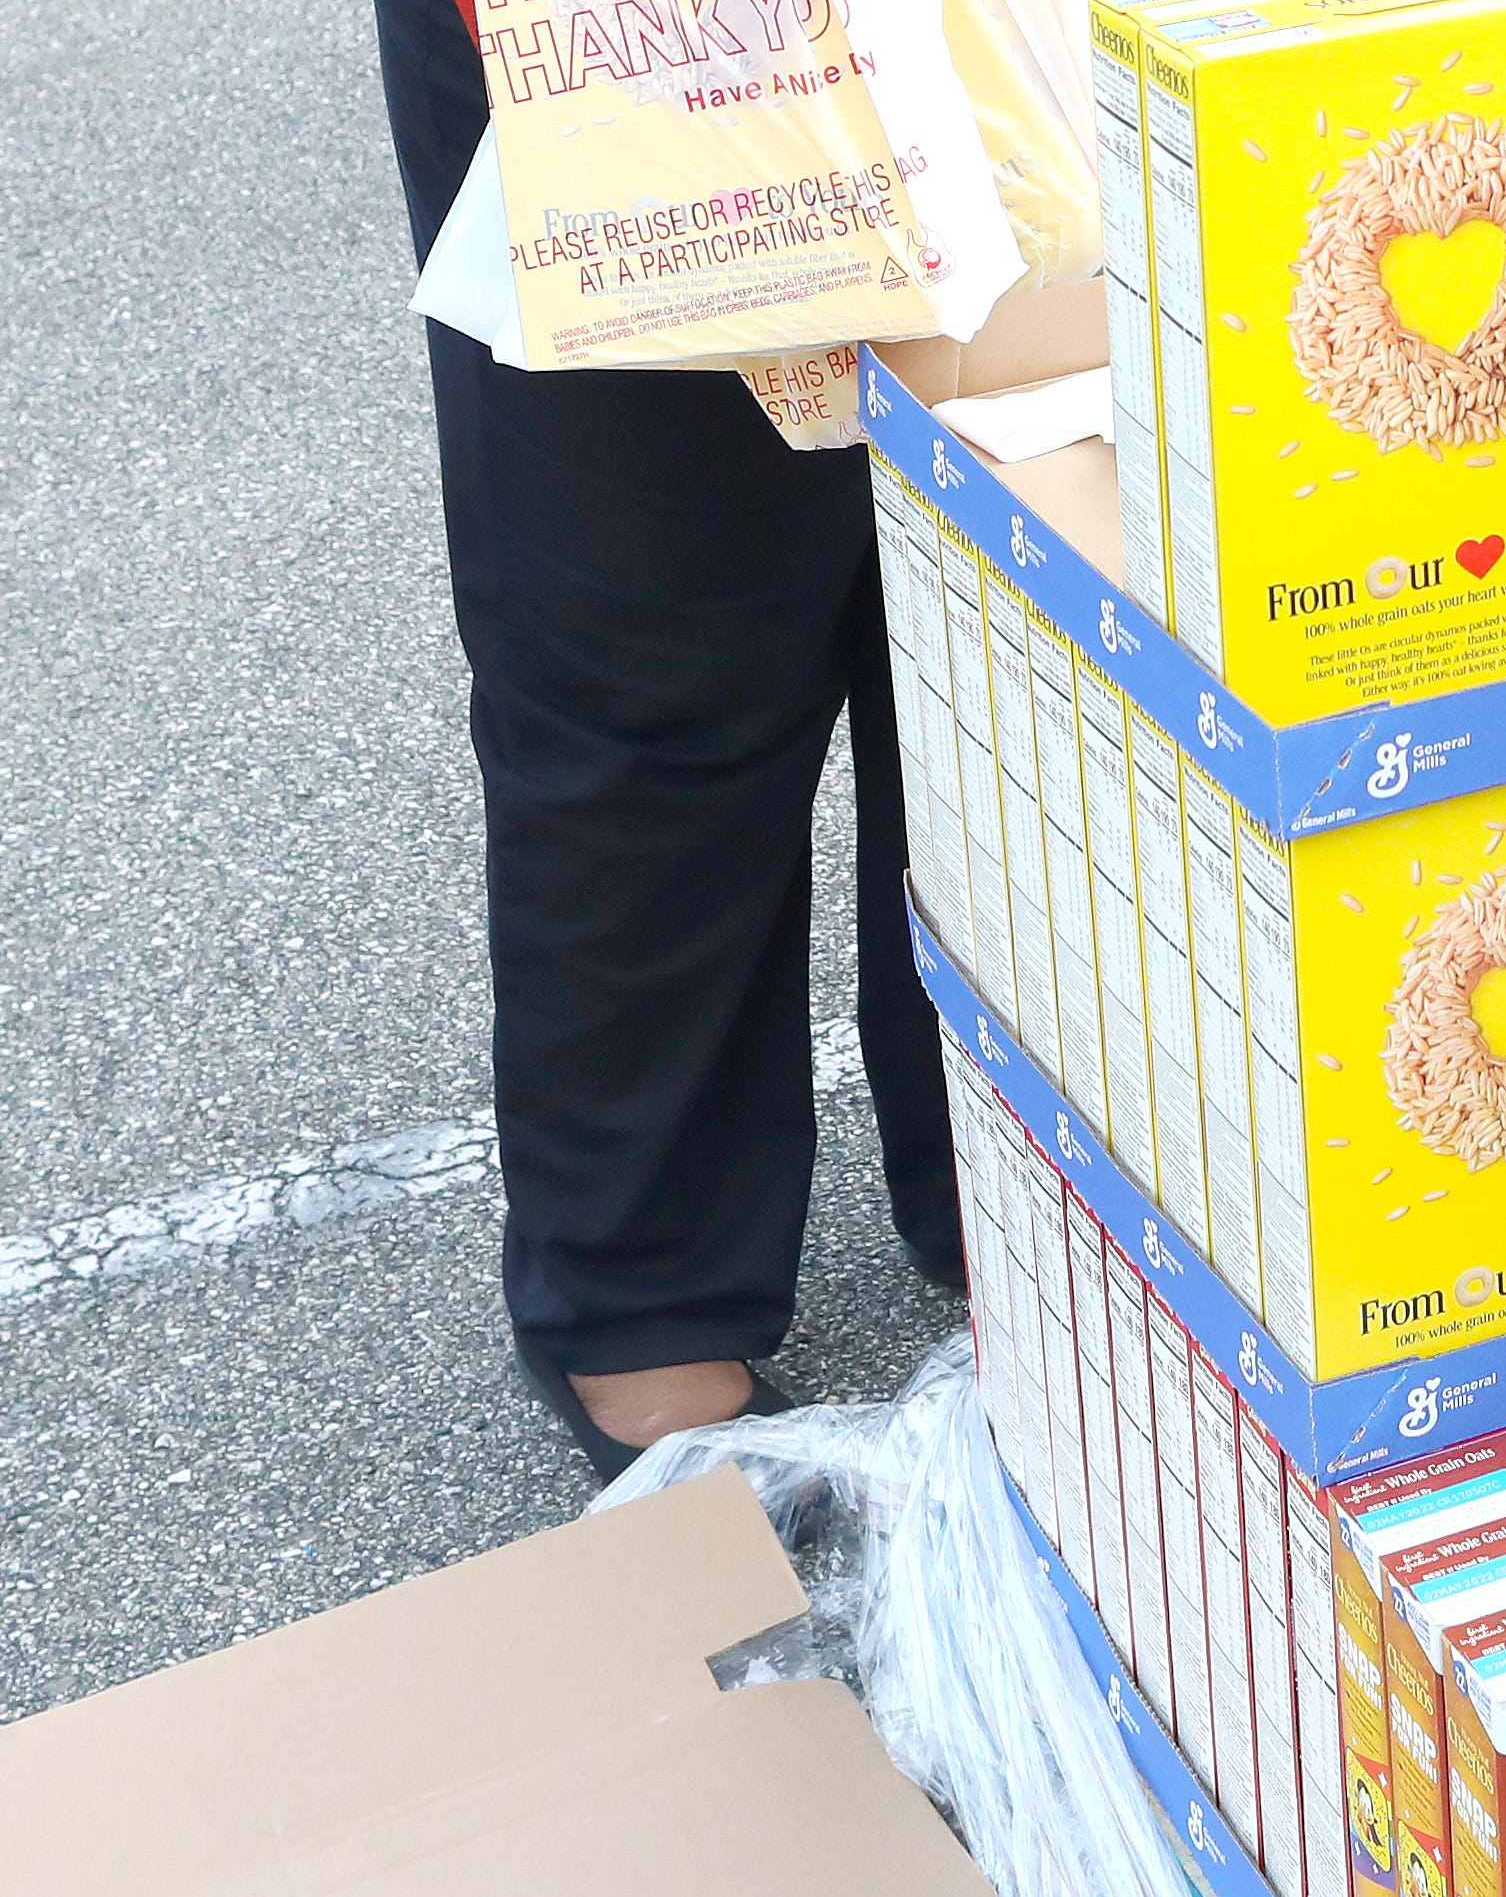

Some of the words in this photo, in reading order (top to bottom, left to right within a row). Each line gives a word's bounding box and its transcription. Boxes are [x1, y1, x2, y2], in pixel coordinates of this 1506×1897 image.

[1091, 12, 1135, 65] Cheerios
[685, 78, 762, 113] Have
[510, 229, 602, 271] PLEASE
[604, 210, 688, 250] REUSE
[690, 198, 729, 232] OR
[733, 171, 846, 221] RECYCLE
[580, 262, 612, 295] AT
[619, 257, 636, 287] A
[643, 218, 825, 280] PARTICIPATING
[1266, 575, 1356, 622] From
[1304, 622, 1336, 639] 100%
[1338, 609, 1375, 631] whole
[1378, 604, 1408, 627] grain
[1411, 600, 1436, 617] oats
[1438, 593, 1466, 620] your
[1467, 585, 1498, 607] heart
[1311, 655, 1333, 666] These
[1337, 649, 1357, 660] little
[1389, 634, 1423, 648] circular
[1425, 625, 1466, 641] dynamos
[1469, 615, 1500, 633] packed
